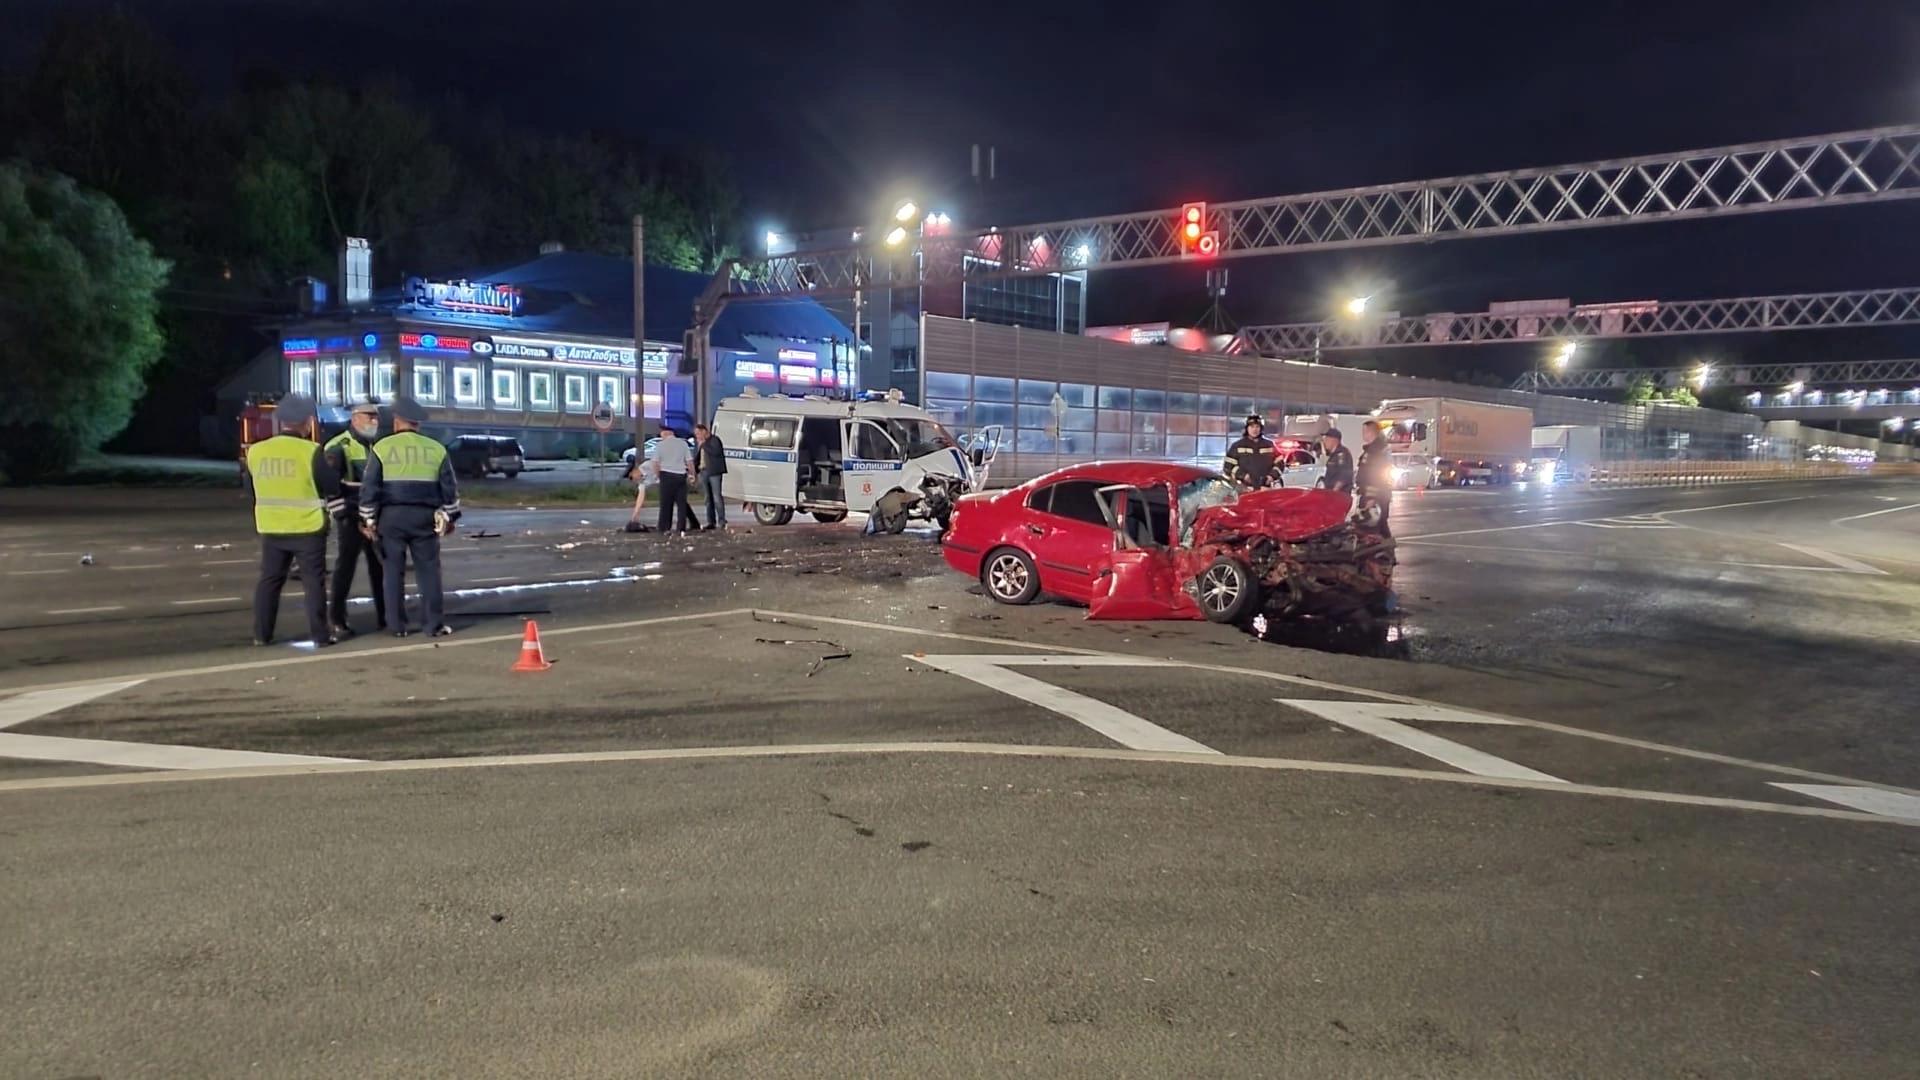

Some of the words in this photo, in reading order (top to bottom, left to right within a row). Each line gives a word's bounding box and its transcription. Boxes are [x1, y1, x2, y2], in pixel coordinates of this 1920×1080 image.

[495, 343, 520, 355] LADA
[385, 446, 436, 465] ДПС
[257, 456, 296, 480] ДПС
[852, 462, 895, 472] ПОЛИЦИЯ
